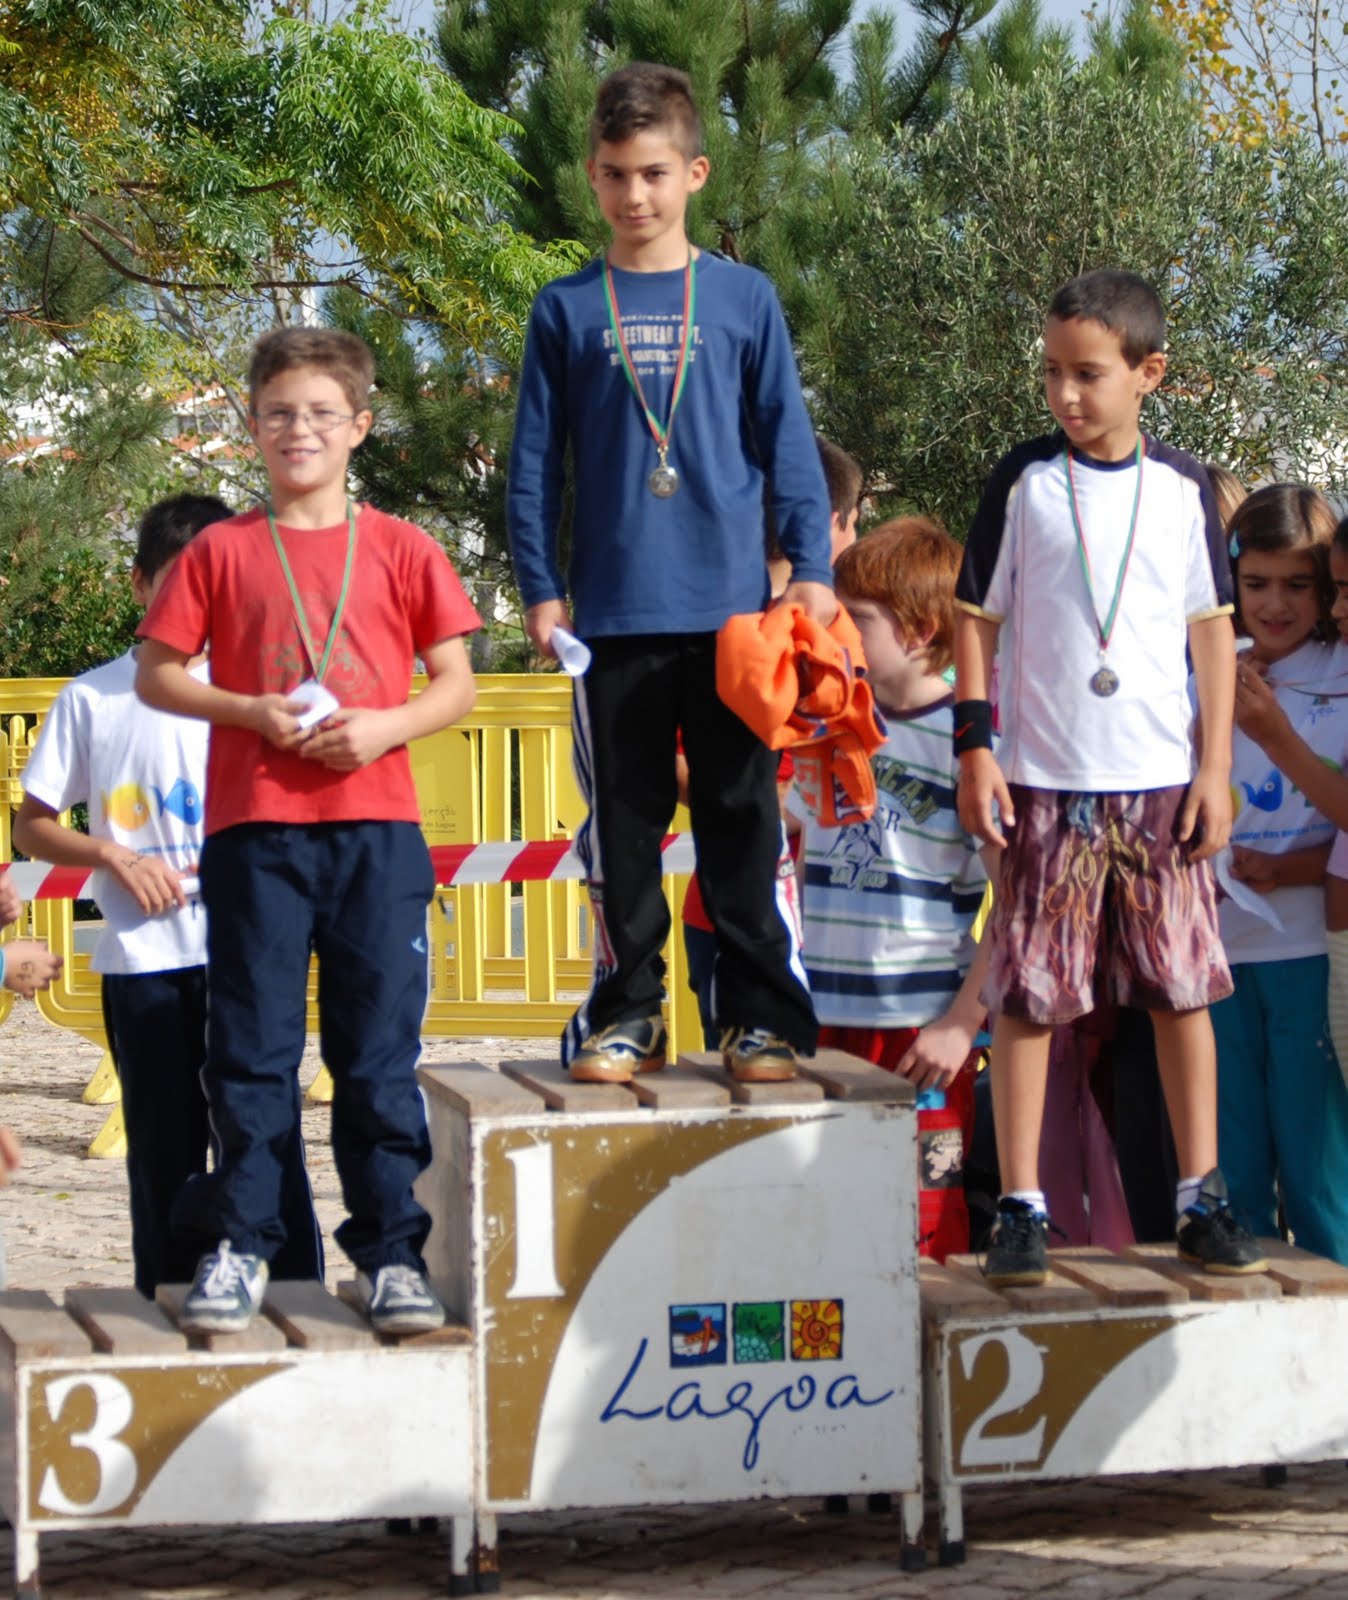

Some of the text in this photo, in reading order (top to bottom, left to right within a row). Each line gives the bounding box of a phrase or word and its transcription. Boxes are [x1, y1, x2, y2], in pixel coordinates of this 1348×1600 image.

[603, 325, 674, 348] STEETWEAR
[505, 1142, 566, 1298] 1
[38, 1373, 138, 1515] 3
[600, 1337, 895, 1471] Lagoa
[959, 1327, 1048, 1466] 2
